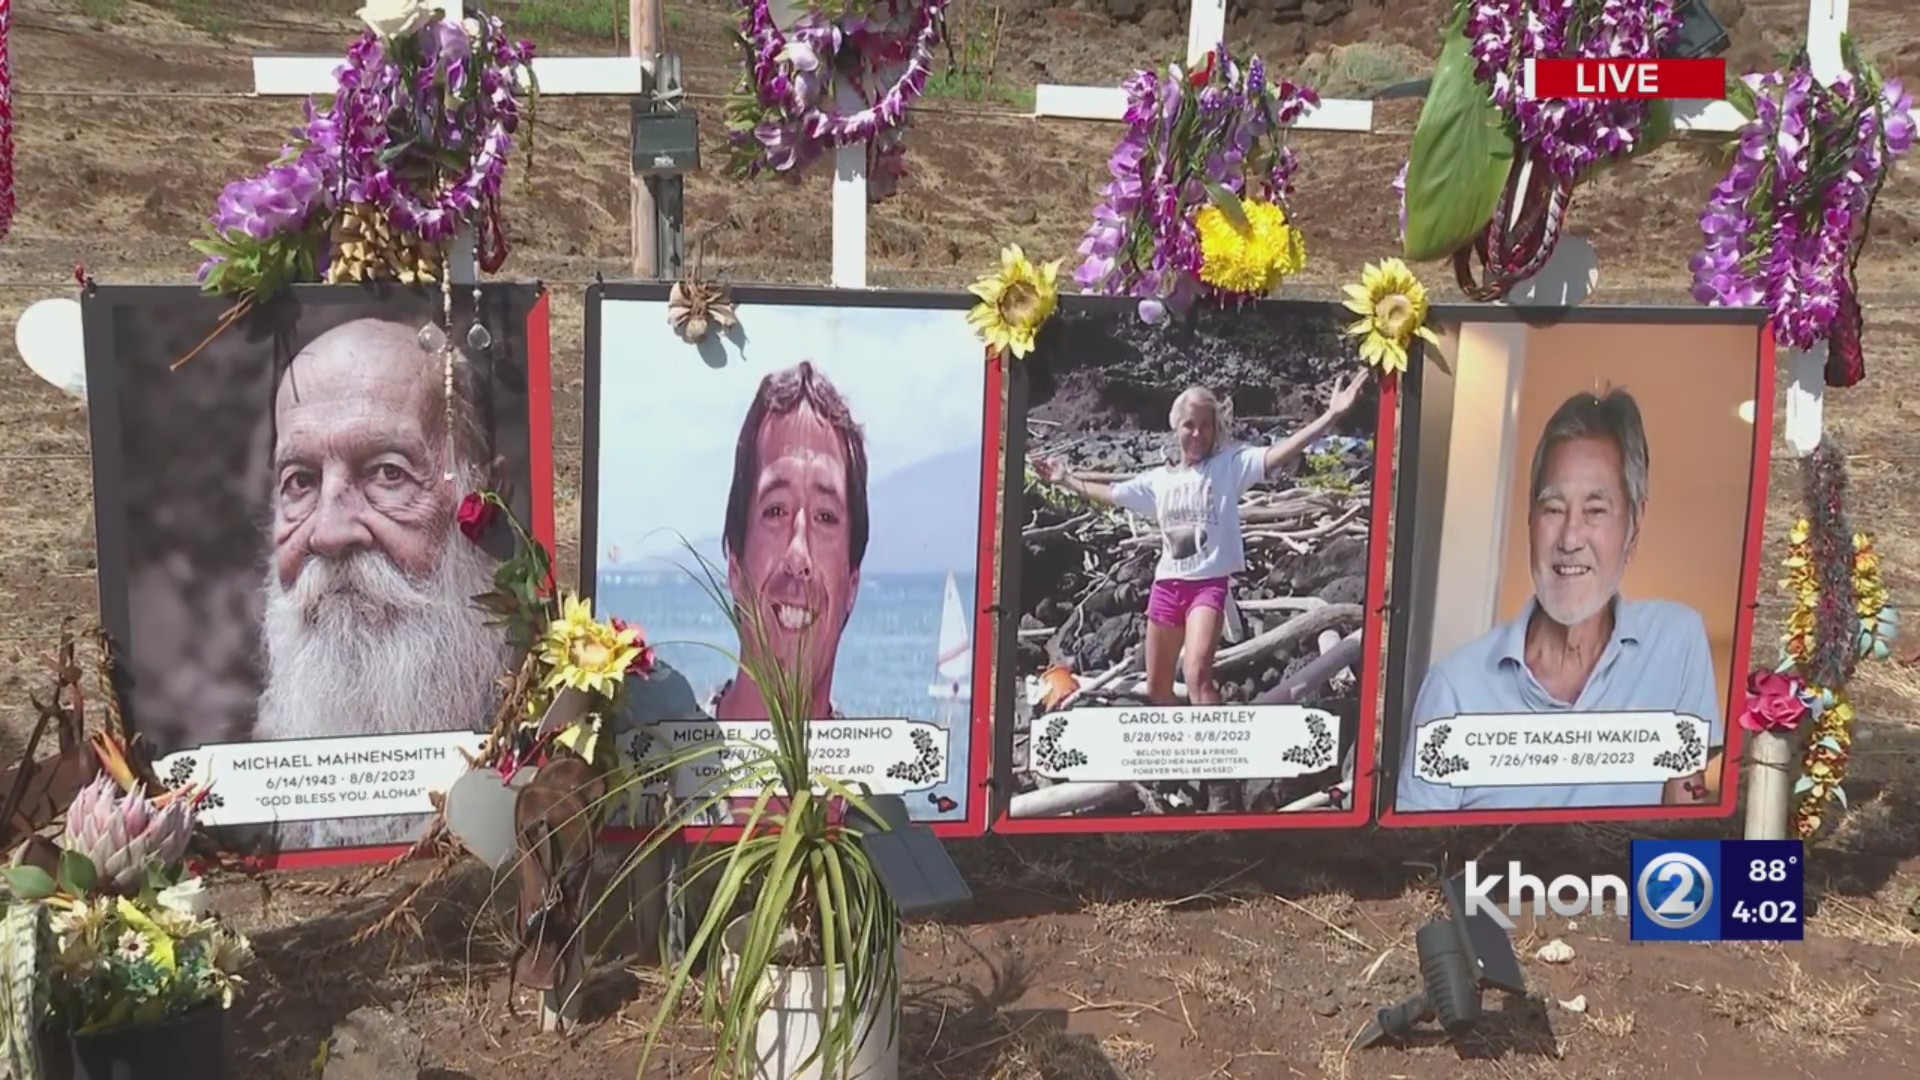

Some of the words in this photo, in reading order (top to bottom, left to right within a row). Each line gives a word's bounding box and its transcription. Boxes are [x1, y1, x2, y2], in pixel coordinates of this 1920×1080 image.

[1118, 711, 1168, 725] CAROL
[1172, 712, 1187, 724] G.
[1191, 711, 1256, 724] HARTLEY
[674, 728, 744, 741] MICHAEL
[817, 727, 893, 740] MORINHO
[1123, 731, 1184, 743] 8/28/1962
[1194, 730, 1251, 743] 8/8/2023
[1465, 731, 1517, 747] CLYDE
[1523, 730, 1592, 745] TAKASHI
[1597, 729, 1661, 744] WAKIDA
[232, 755, 313, 771] MICHAEL
[317, 747, 446, 766] MAHNENSMITH
[1489, 754, 1558, 767] 7/26/1949
[1570, 752, 1635, 766] 8/8/2023
[848, 764, 875, 775] AND
[266, 774, 337, 790] 6/14/1943
[349, 769, 415, 785] 8/8/2023
[256, 795, 291, 807] "GOD
[295, 792, 336, 805] BLESS
[339, 791, 369, 802] YOU.
[372, 787, 427, 800] ALOHA!"
